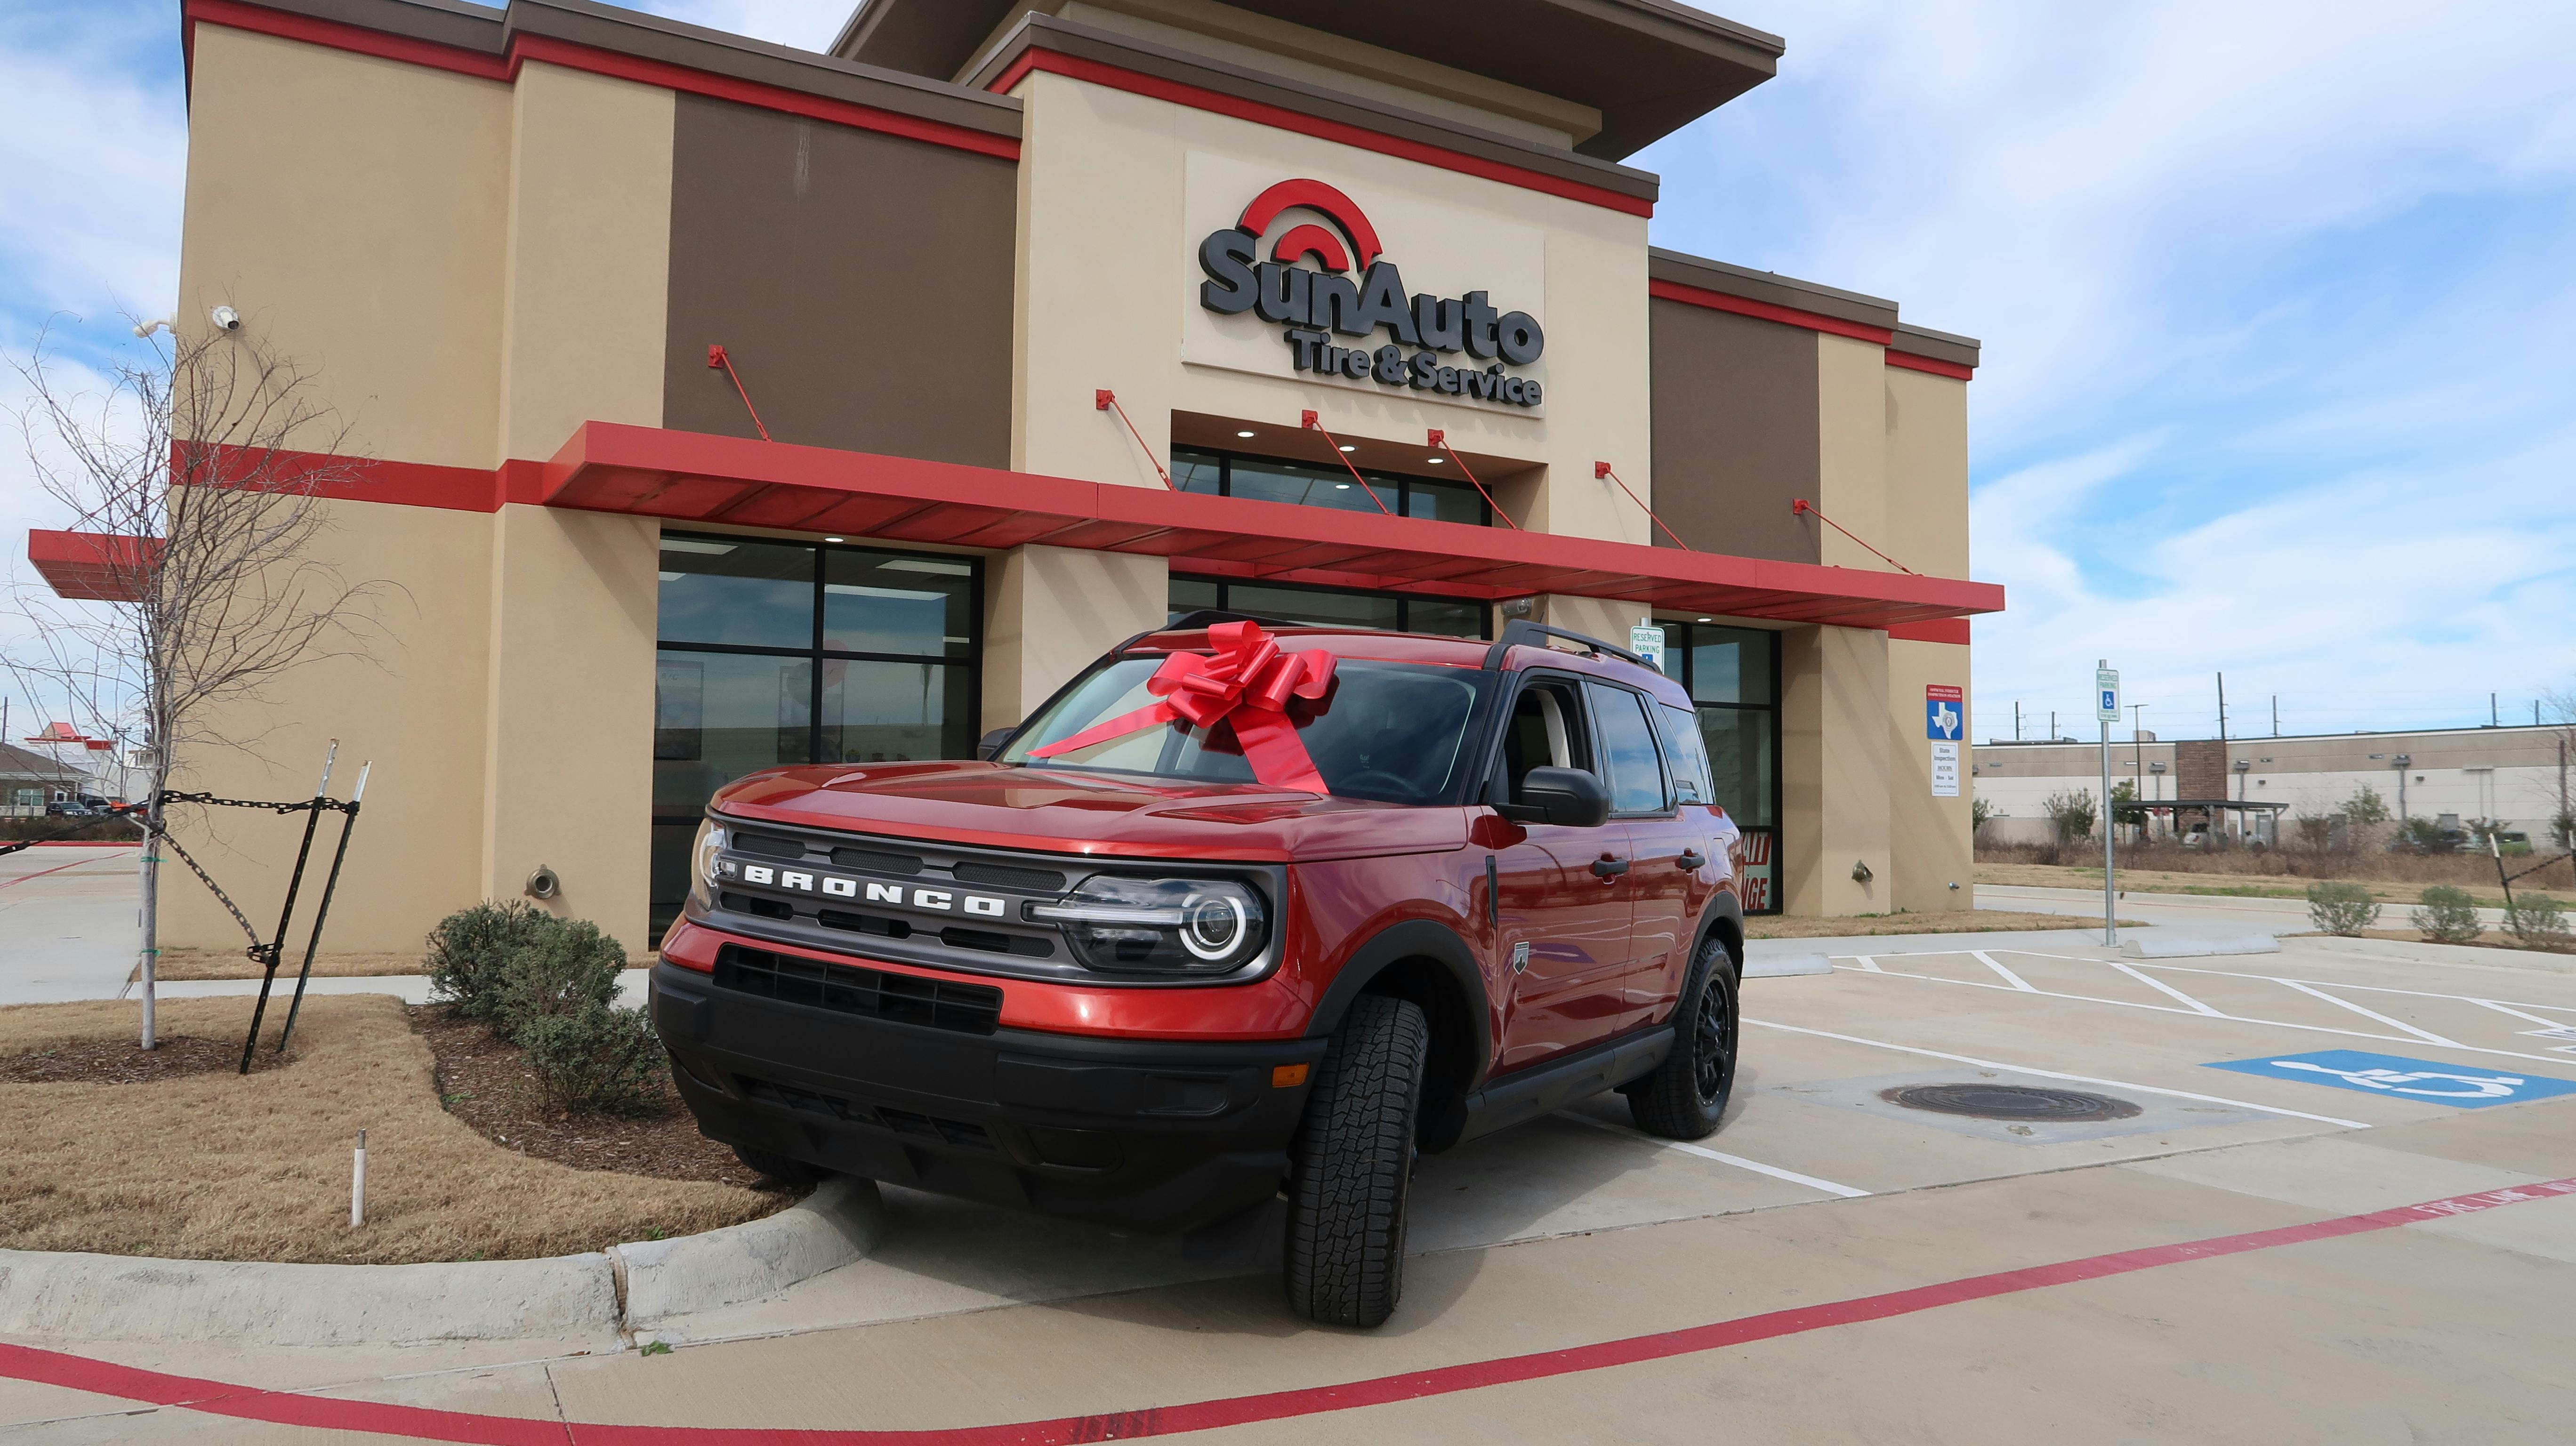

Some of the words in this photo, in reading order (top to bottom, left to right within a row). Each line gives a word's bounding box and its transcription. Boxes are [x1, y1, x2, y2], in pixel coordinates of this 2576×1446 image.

[1199, 229, 1544, 366] SunAuto
[1284, 329, 1370, 379] Tire
[1371, 345, 1409, 386] &
[1409, 352, 1542, 407] Service
[1634, 633, 1661, 643] RESERVED
[1635, 644, 1660, 653] PARKING
[745, 865, 1006, 917] BRONCO
[2412, 1200, 2486, 1216] FIRE
[2466, 1189, 2544, 1205] LANE
